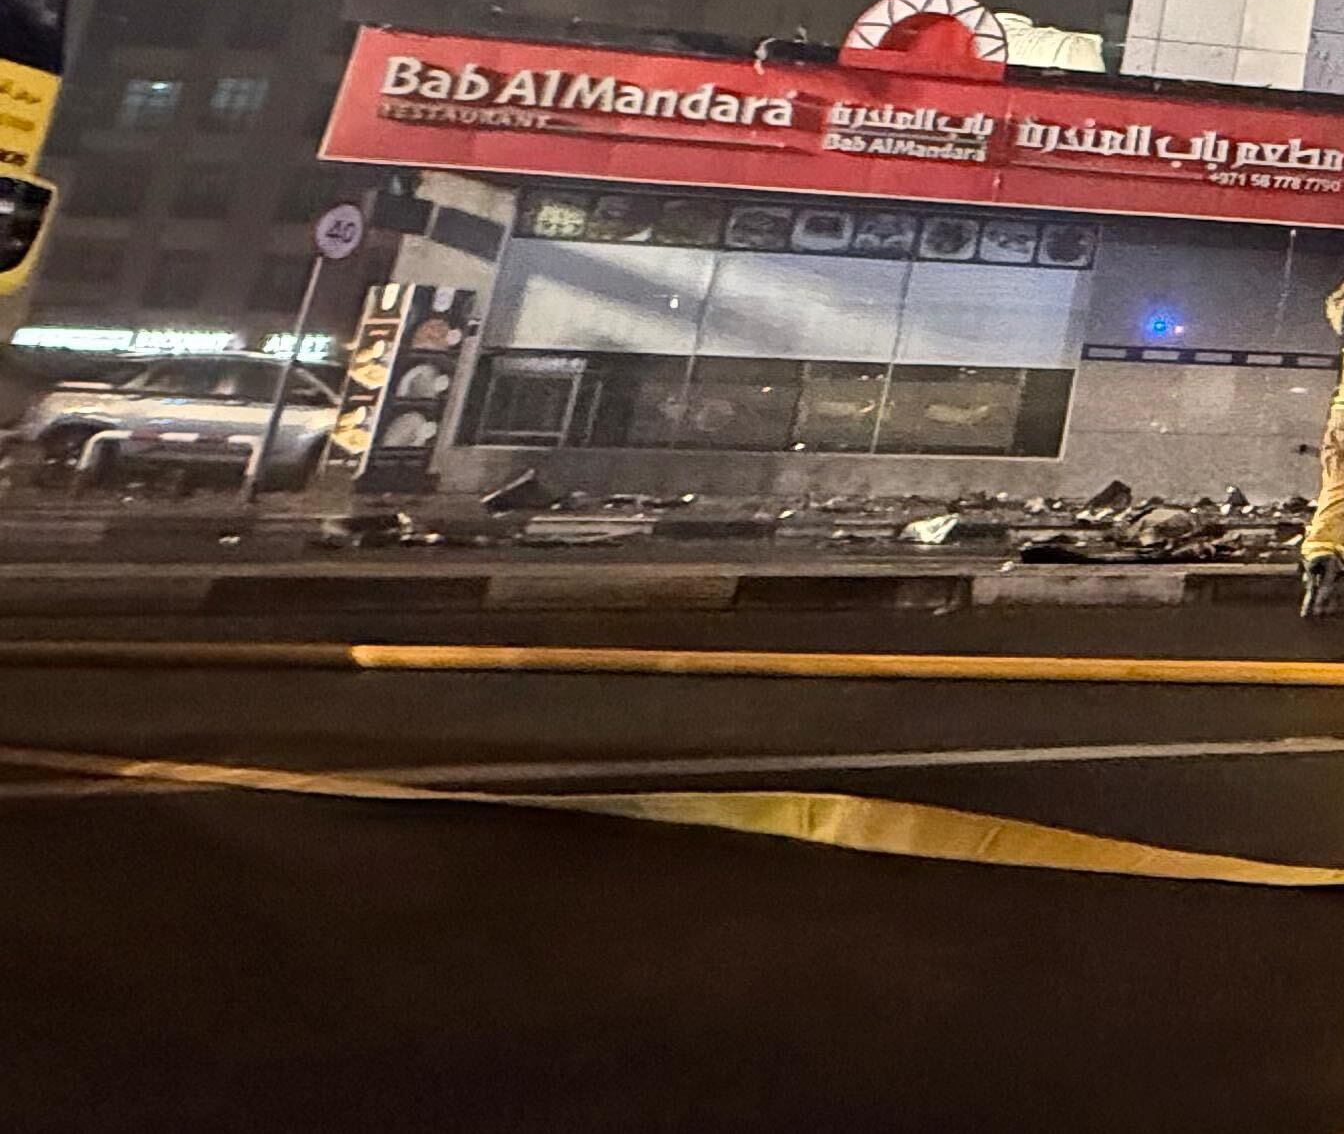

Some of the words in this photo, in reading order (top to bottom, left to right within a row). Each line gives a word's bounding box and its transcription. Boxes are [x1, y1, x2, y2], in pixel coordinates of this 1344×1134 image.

[381, 56, 491, 102] Bab
[1015, 116, 1152, 155] المندرة
[1155, 131, 1229, 170] باب
[1231, 138, 1344, 172] مطعم
[325, 220, 357, 244] 40
